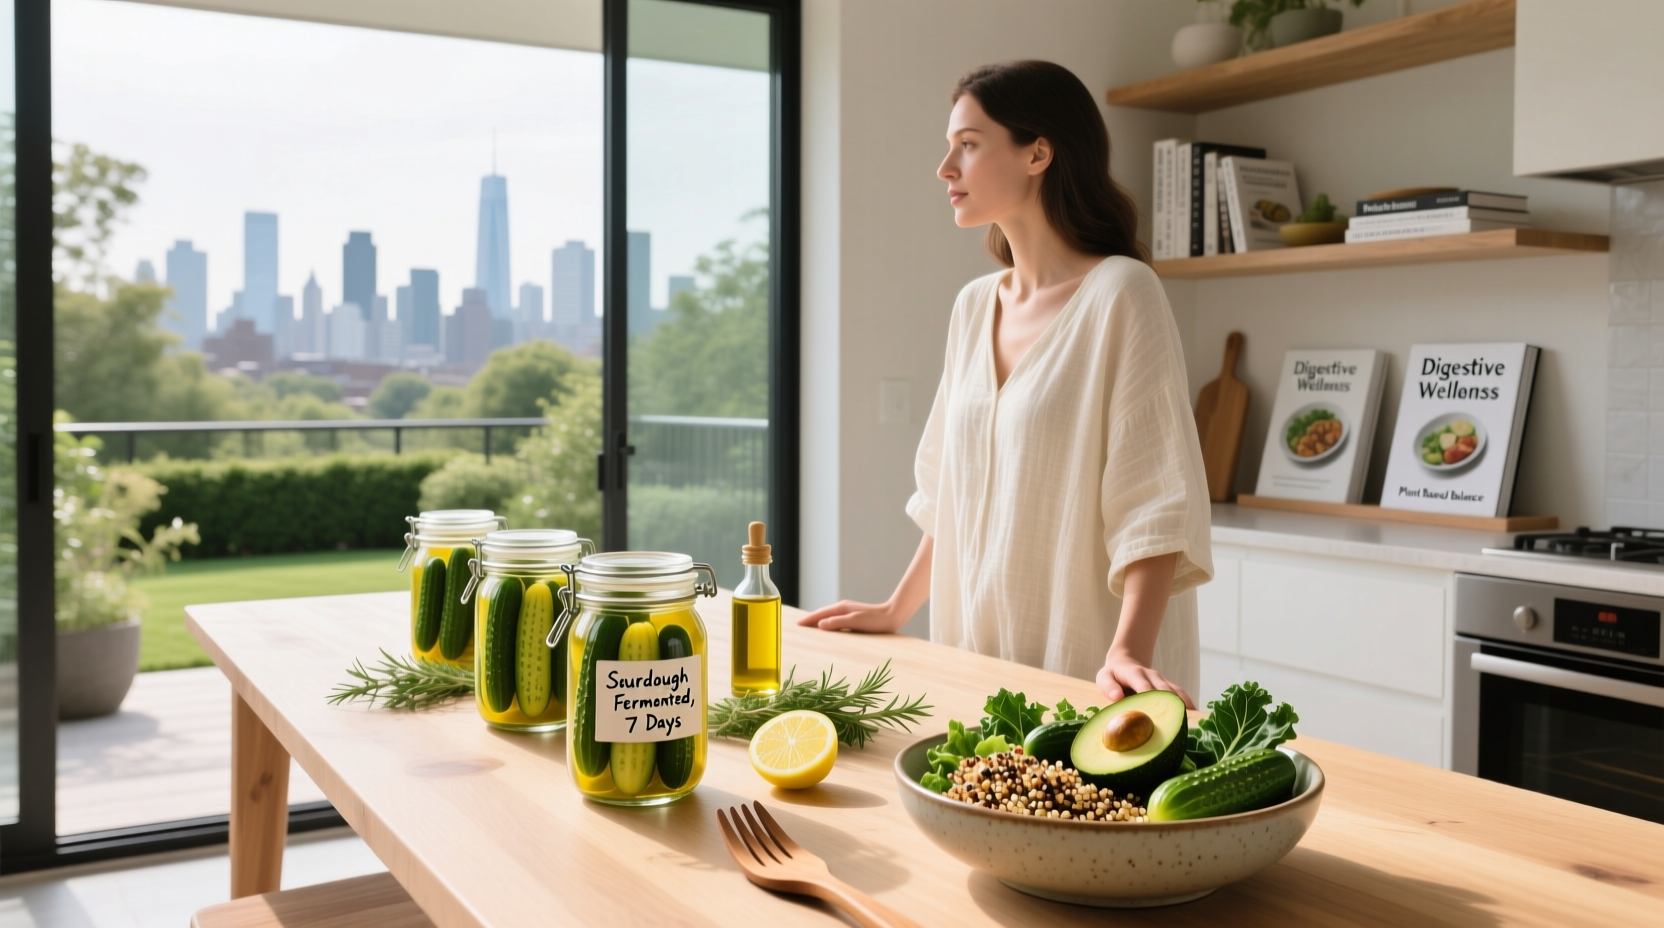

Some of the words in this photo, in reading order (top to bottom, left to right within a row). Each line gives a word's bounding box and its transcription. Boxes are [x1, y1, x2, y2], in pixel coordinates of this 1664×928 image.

[1293, 360, 1357, 380] Digestive
[1421, 357, 1505, 381] Digestive
[625, 716, 638, 734] 7
[646, 713, 682, 736] Days
